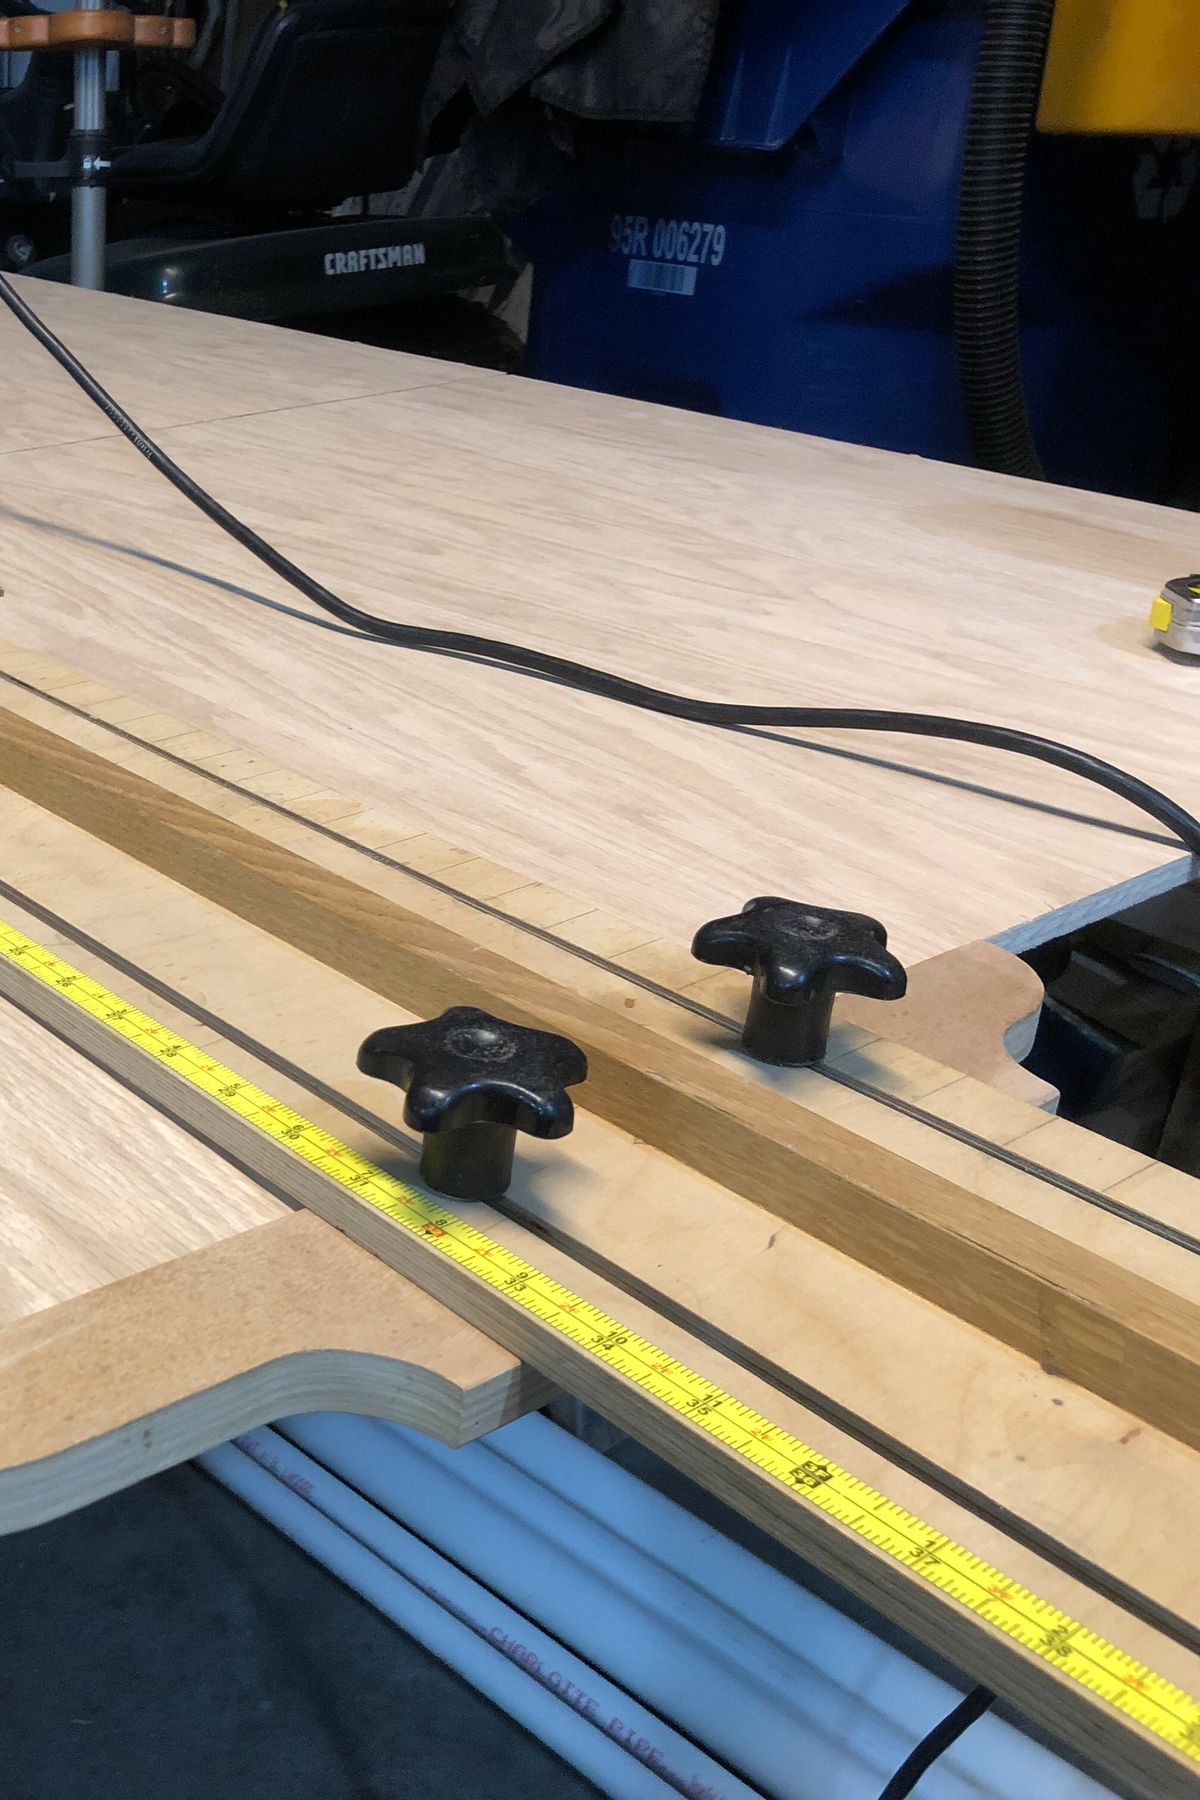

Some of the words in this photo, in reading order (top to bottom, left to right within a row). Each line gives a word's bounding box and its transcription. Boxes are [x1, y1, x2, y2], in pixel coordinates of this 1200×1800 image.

[324, 243, 425, 275] CRAFTSMAN
[652, 217, 727, 266] 006279
[281, 1129, 300, 1140] 30
[349, 1175, 369, 1186] 31
[504, 1278, 527, 1292] 33
[591, 1335, 615, 1351] 34
[686, 1399, 712, 1416] 35
[909, 1547, 941, 1567] 37
[517, 1271, 529, 1280] 9
[607, 1330, 628, 1345] 10
[703, 1394, 723, 1408] 11
[606, 1717, 664, 1764] PIPE
